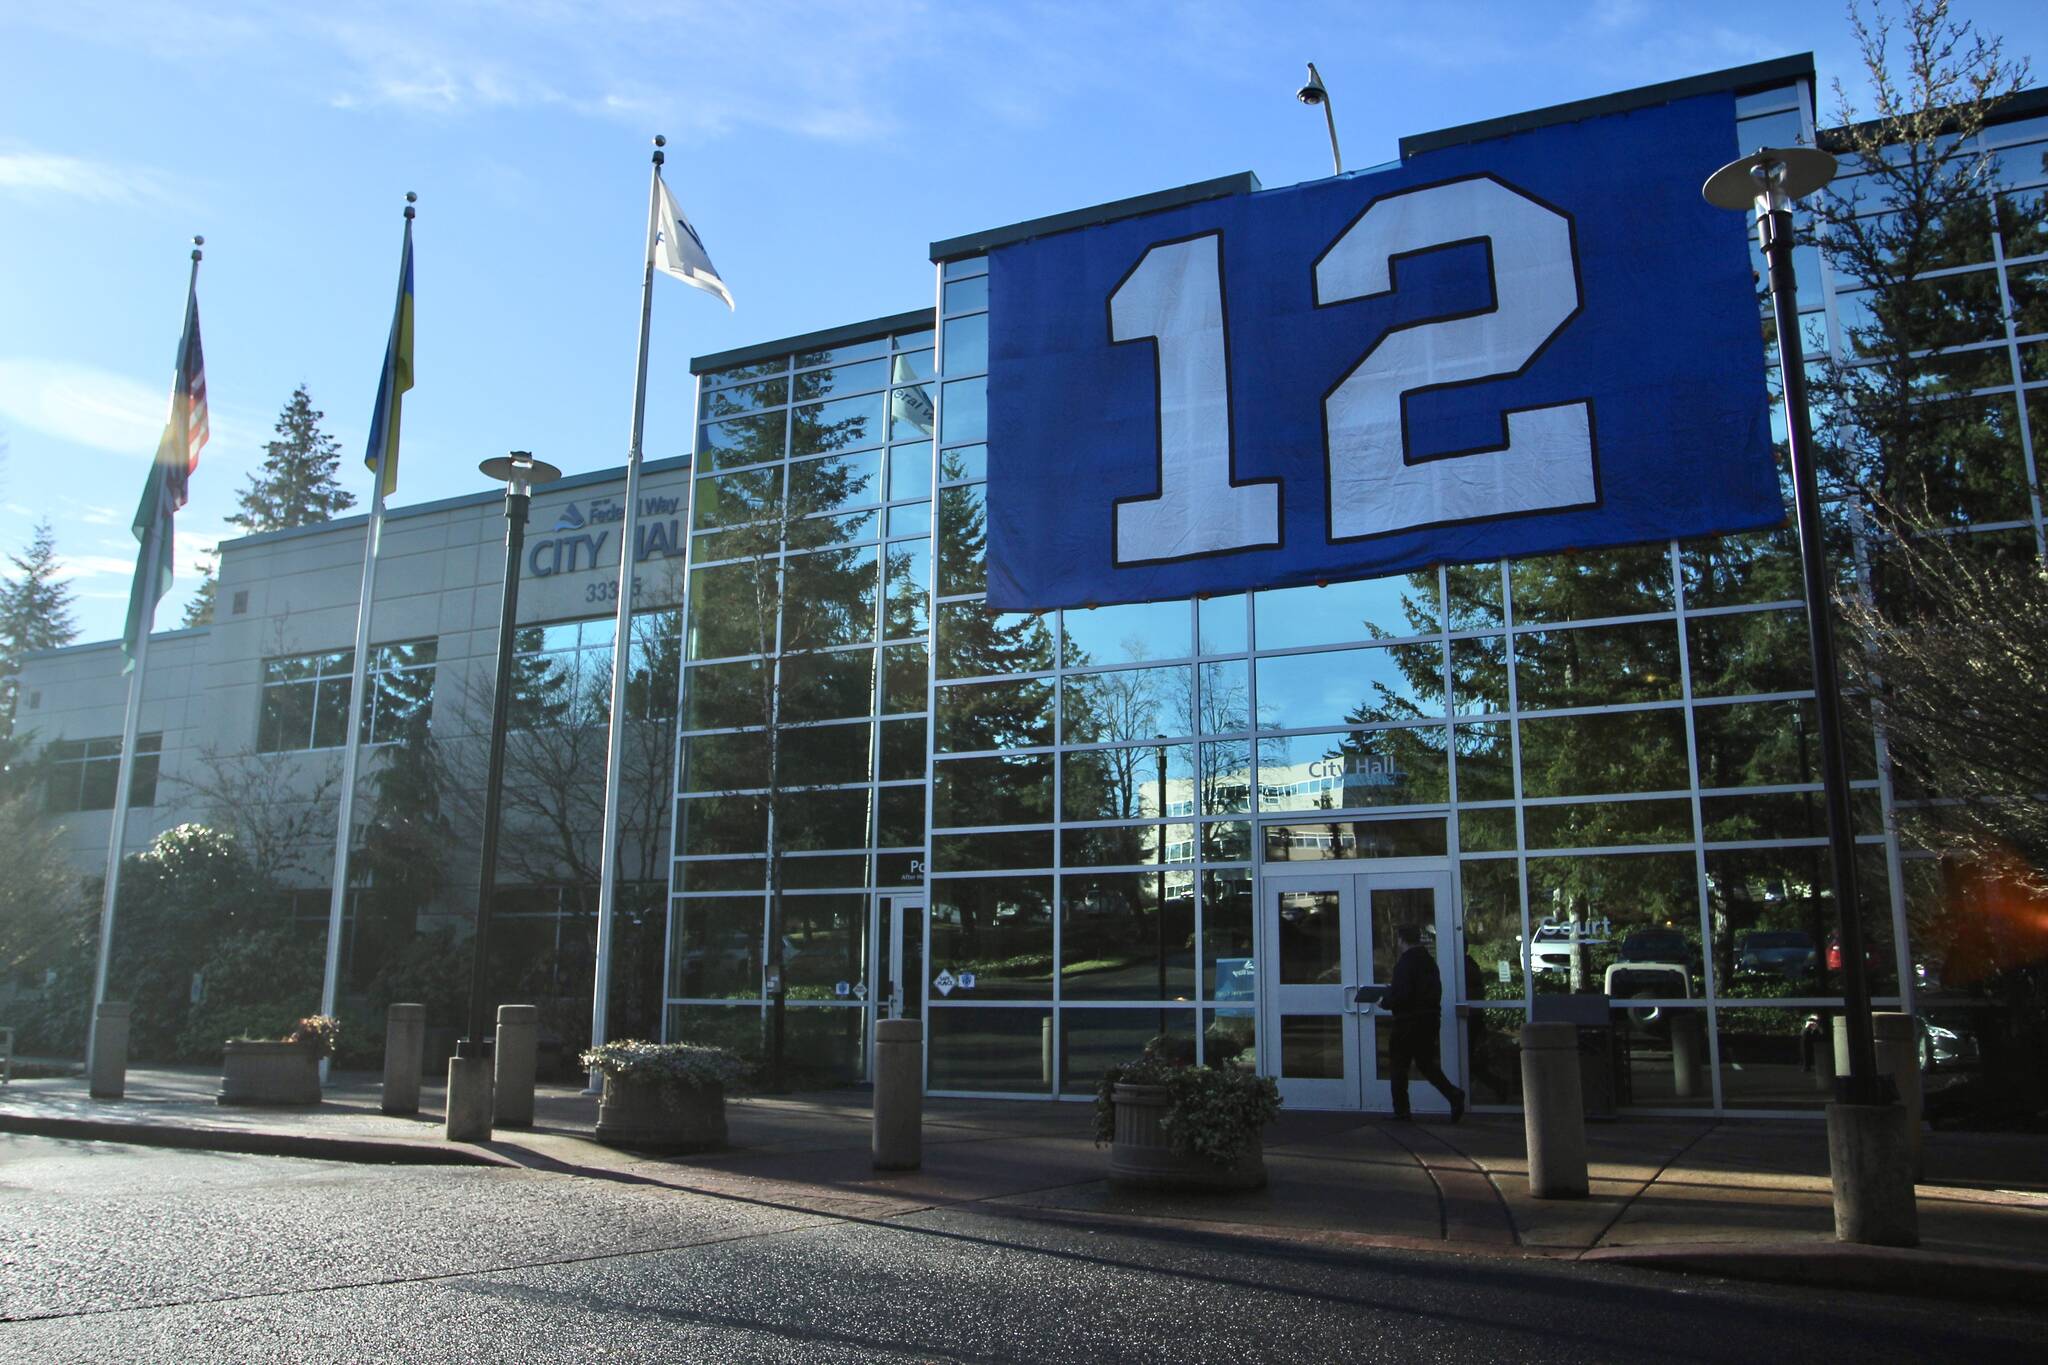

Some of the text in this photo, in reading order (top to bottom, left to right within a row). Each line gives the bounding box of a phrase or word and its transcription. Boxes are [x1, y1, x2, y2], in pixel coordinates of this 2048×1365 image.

[1105, 171, 1601, 568] 12
[645, 496, 680, 515] Way
[529, 531, 608, 577] CITY
[585, 577, 642, 602] 3335
[1308, 755, 1395, 781] City Hall
[1540, 916, 1612, 936] Court
